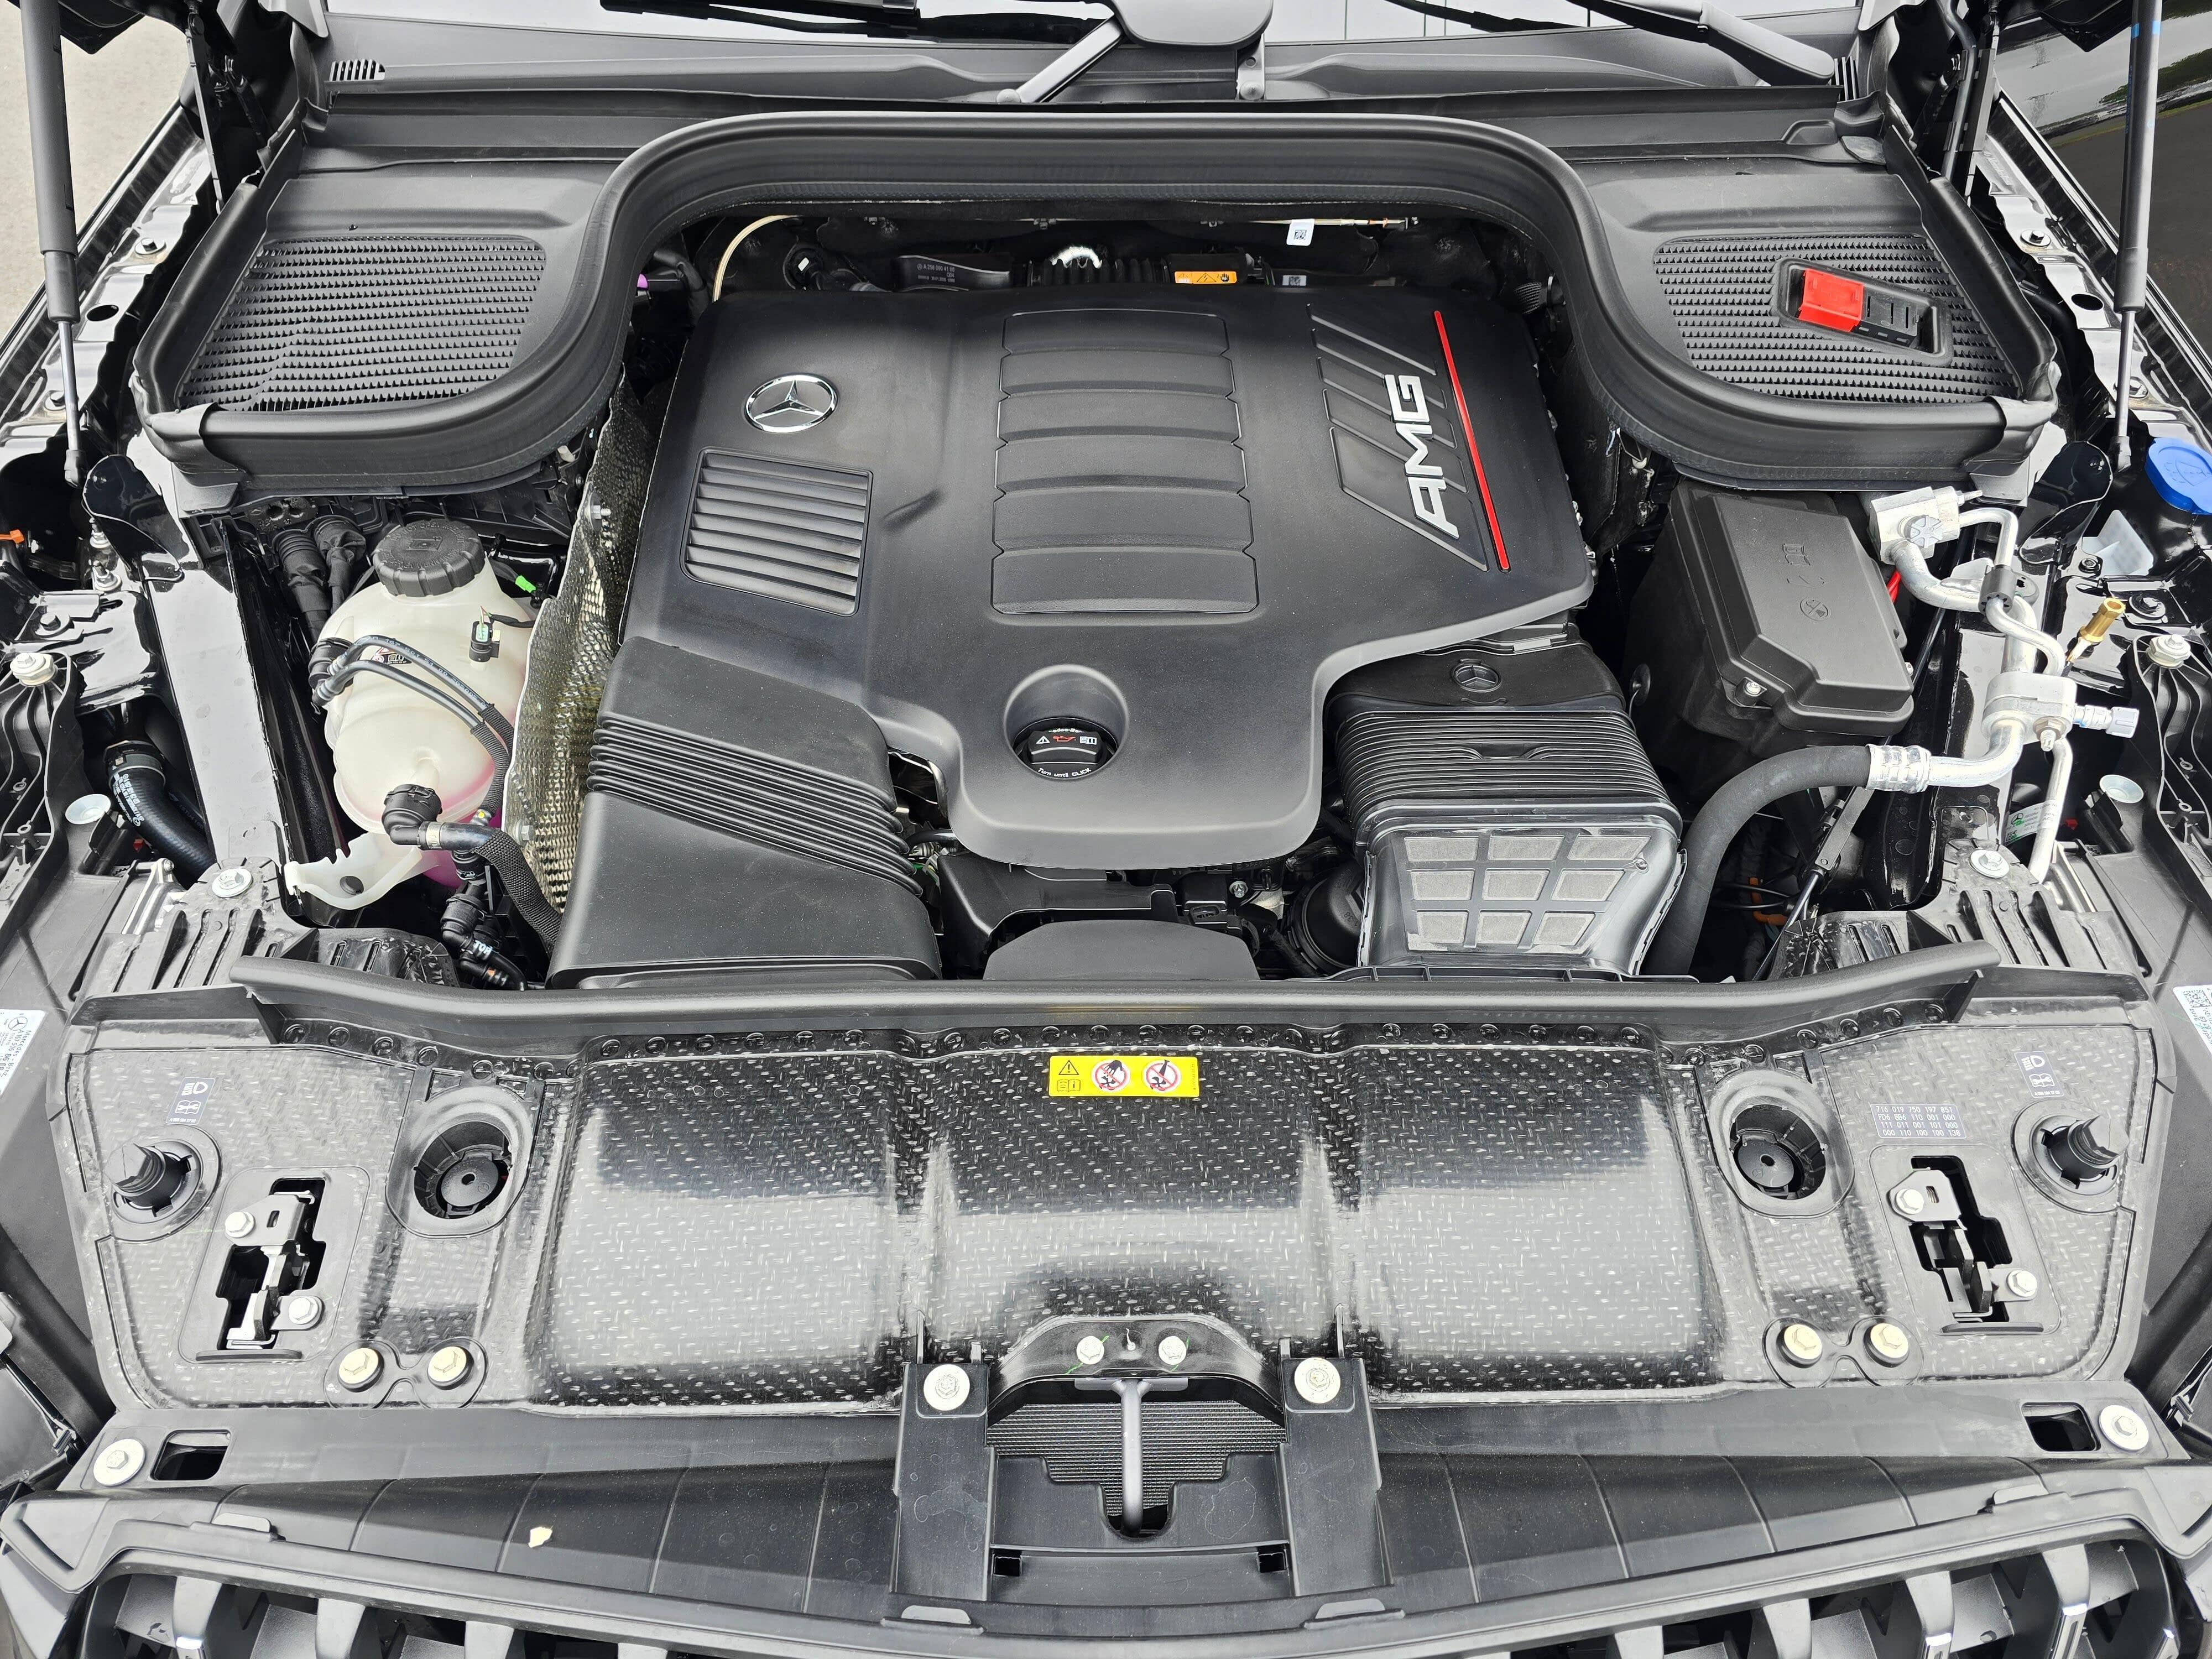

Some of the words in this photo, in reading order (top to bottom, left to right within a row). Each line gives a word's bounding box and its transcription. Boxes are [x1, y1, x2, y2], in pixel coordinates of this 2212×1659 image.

[1385, 374, 1459, 539] AMG
[1038, 768, 1052, 776] Turn
[1072, 768, 1092, 777] CLICK
[8, 1042, 17, 1051] 906
[13, 1030, 32, 1056] Mercedes
[2, 1062, 14, 1076] Benz
